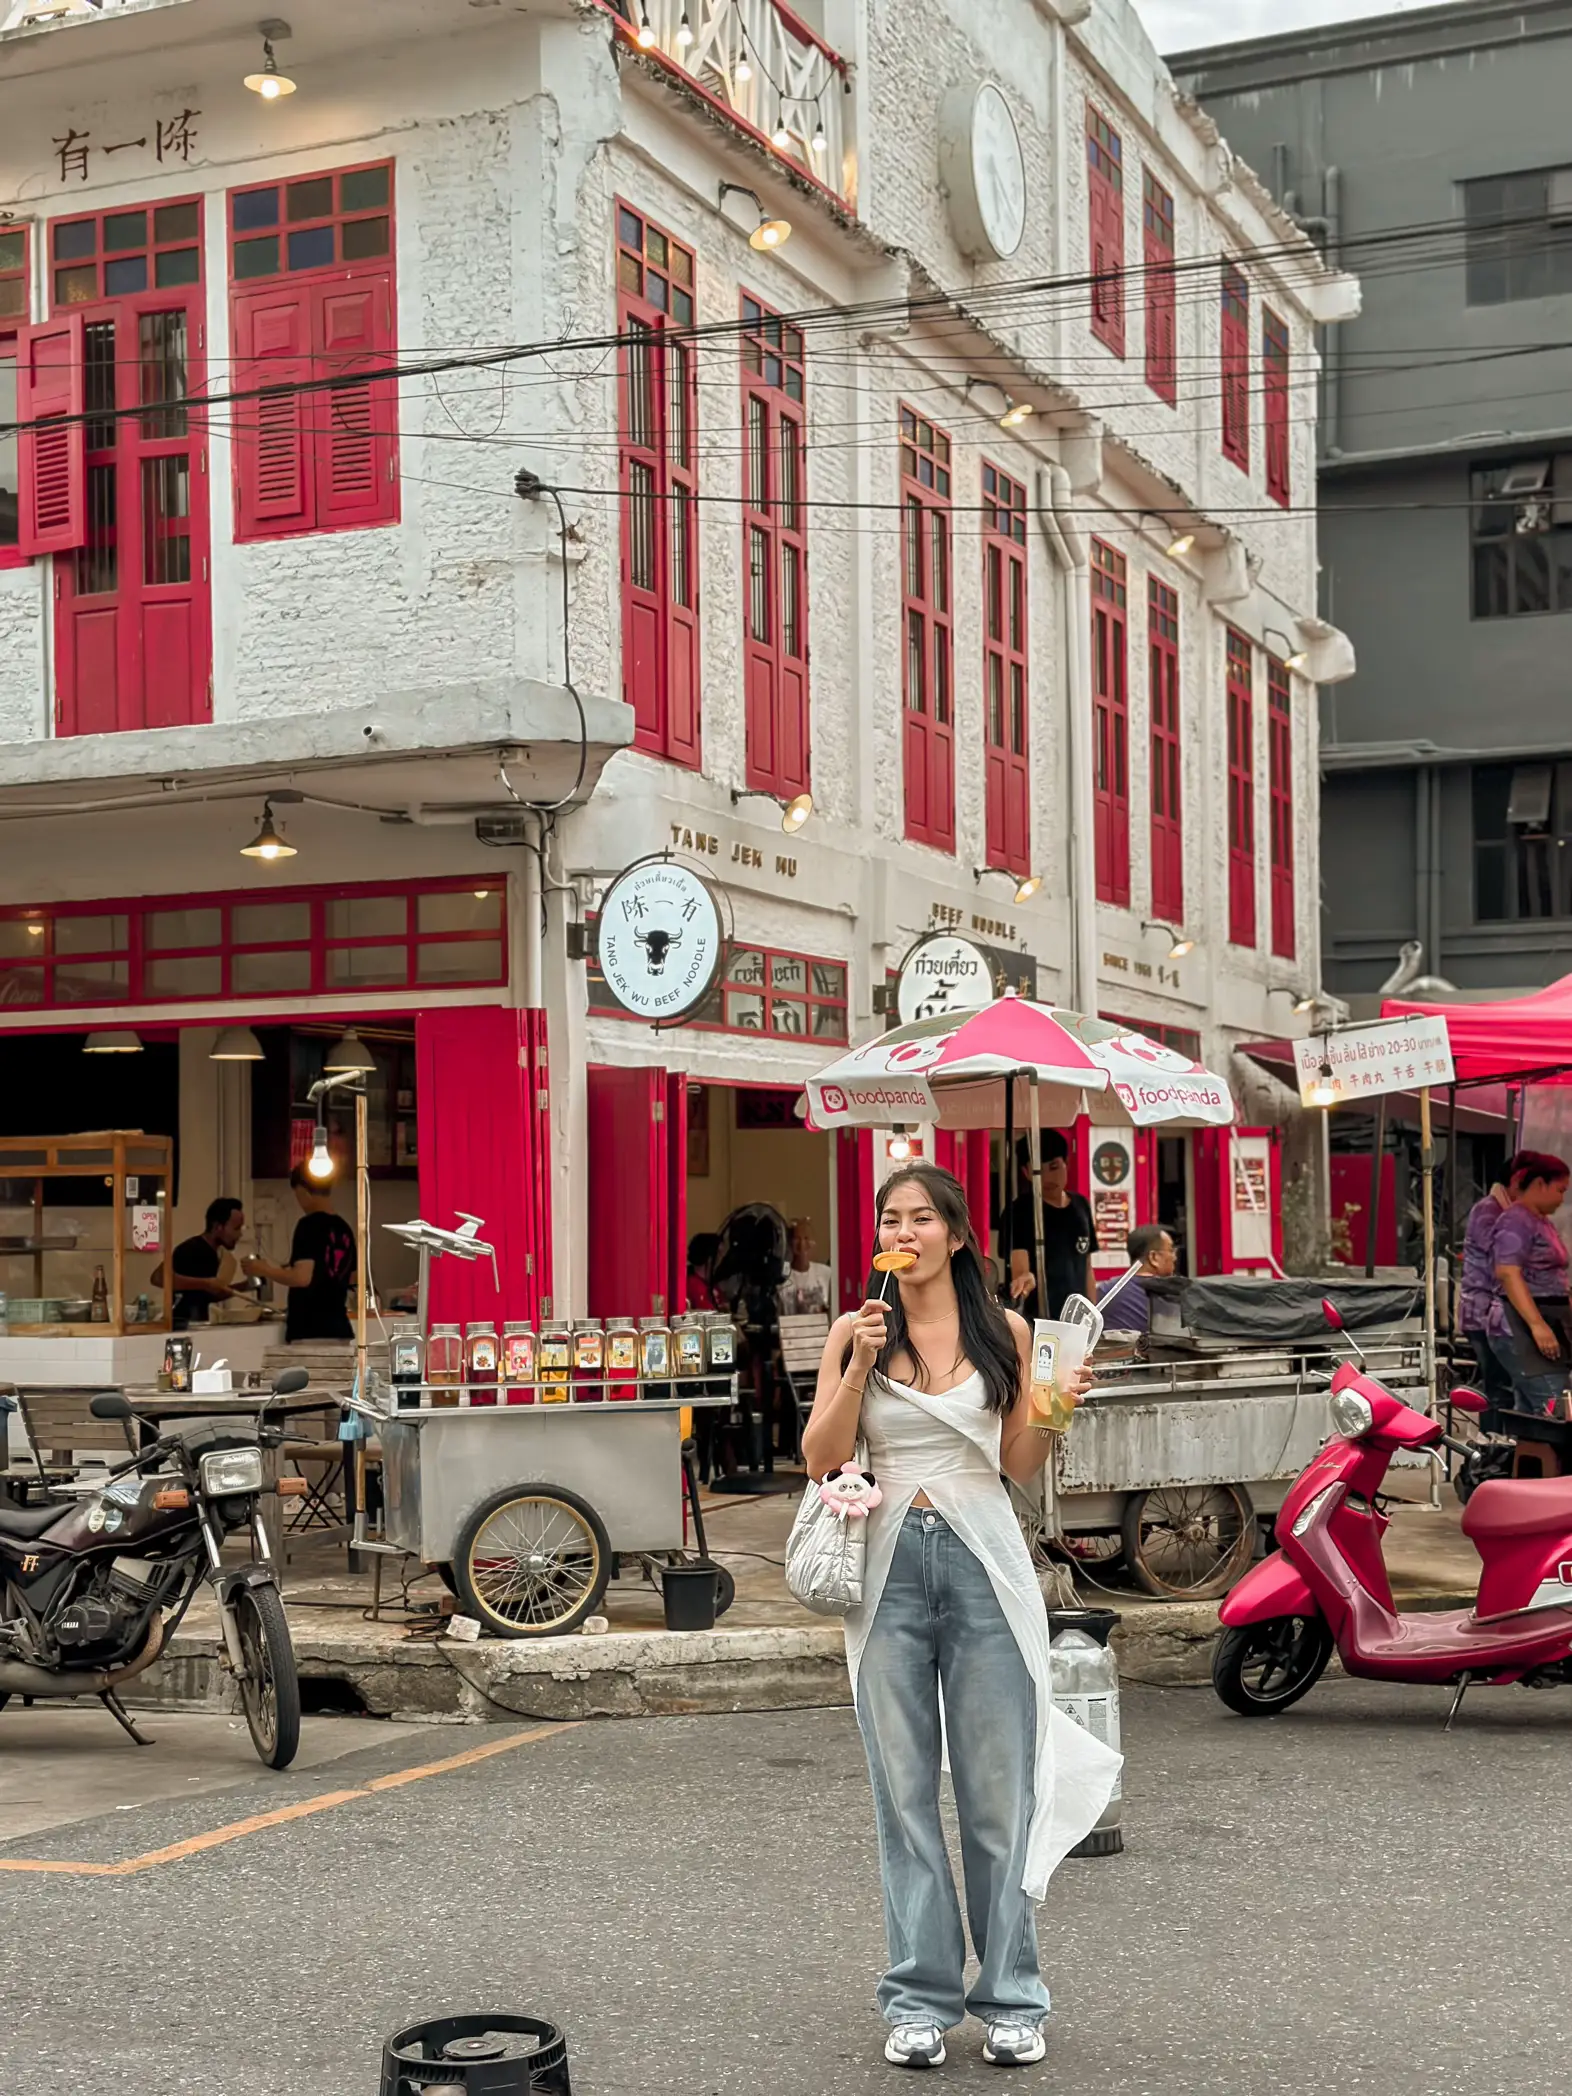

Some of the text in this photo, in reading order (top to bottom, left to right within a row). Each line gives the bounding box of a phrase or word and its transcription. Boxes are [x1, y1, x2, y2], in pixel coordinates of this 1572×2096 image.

[670, 822, 719, 855] TANG
[731, 843, 763, 868] JEK
[932, 902, 1016, 940] BEEF NOODLE
[606, 935, 706, 1007] TANG JEK WU BEEF NOODLE
[1318, 1046, 1342, 1067] ลกชิ้น
[1388, 1037, 1416, 1054] 20-30
[1349, 1072, 1385, 1088] 牛肉丸
[1392, 1064, 1415, 1080] 牛舌
[848, 1086, 927, 1108] foodpanda
[1139, 1085, 1221, 1105] foodpanda
